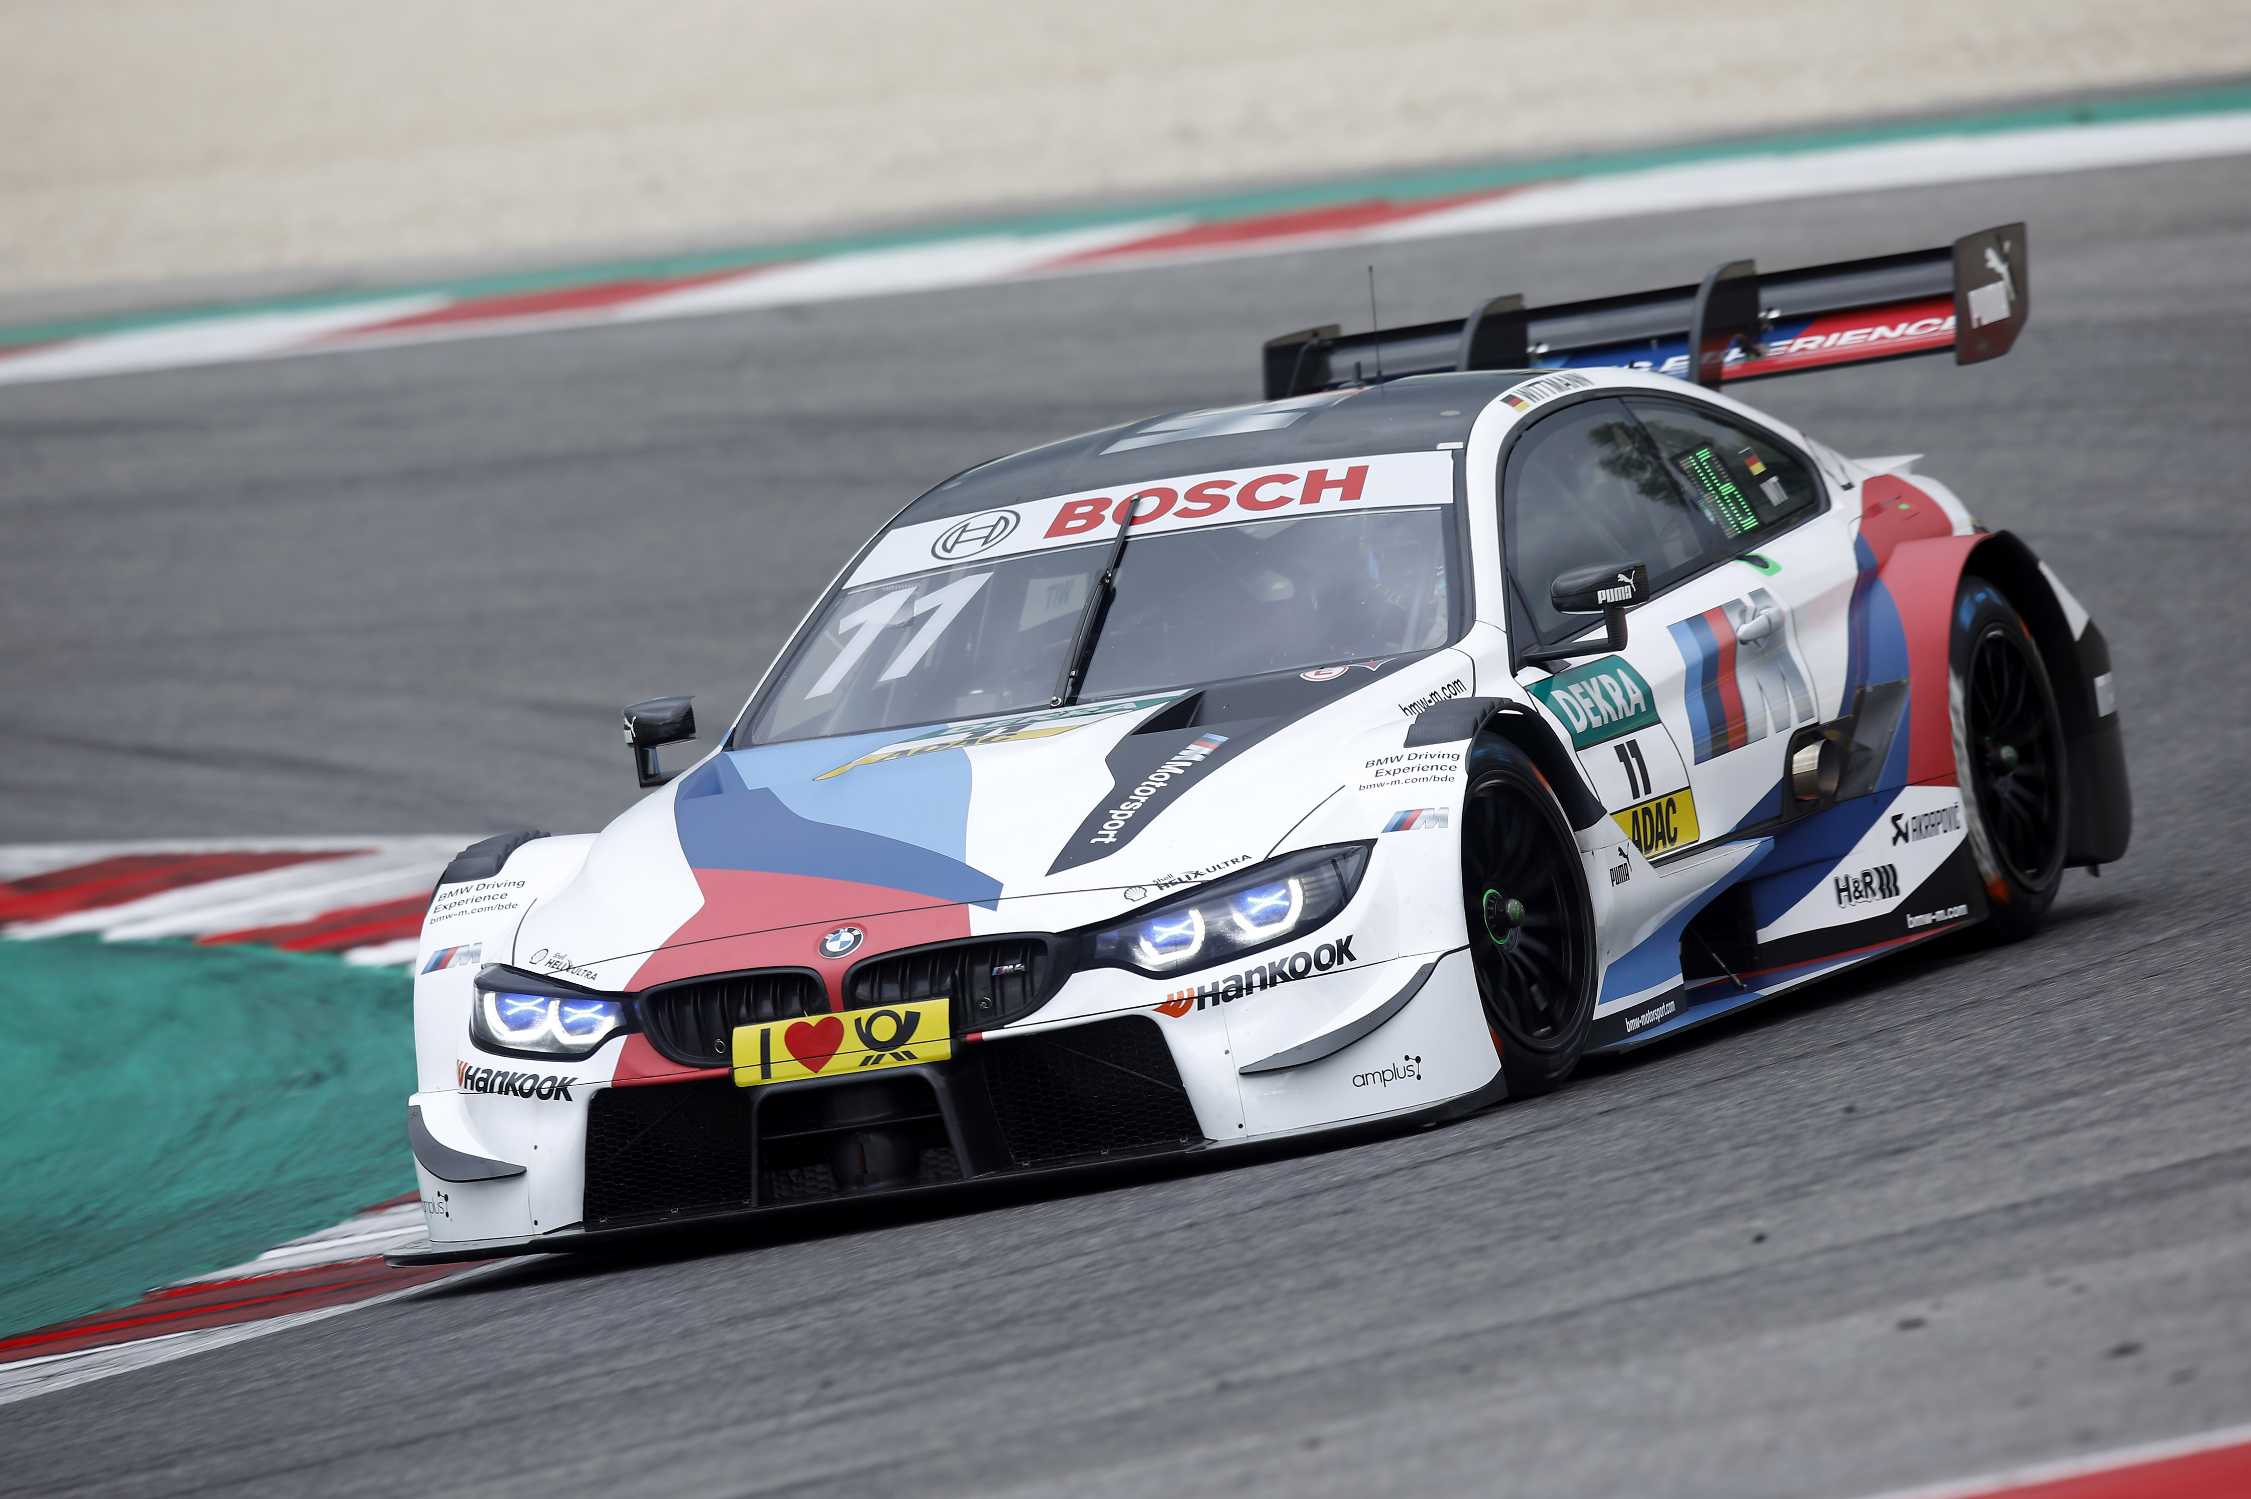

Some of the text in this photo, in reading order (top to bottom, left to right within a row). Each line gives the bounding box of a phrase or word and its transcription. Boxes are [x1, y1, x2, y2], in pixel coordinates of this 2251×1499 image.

[1044, 464, 1370, 538] BOSCH
[803, 571, 994, 701] 11
[1550, 668, 1647, 735] DEKRA
[1365, 751, 1461, 769] BMW Driving
[1374, 762, 1458, 779] Experience
[1613, 738, 1652, 800] 11
[1358, 775, 1456, 792] bmw-m.com/bde
[1089, 760, 1193, 845] Motorsport
[1630, 797, 1678, 853] ADAC
[1205, 854, 1253, 873] ULTRA
[433, 892, 509, 914] Experience
[437, 880, 526, 902] BMW Driving
[429, 902, 519, 926] bmw-m.com/bde
[1197, 935, 1358, 1011] Hankook
[760, 1028, 773, 1080] I
[464, 1065, 578, 1102] Hankook
[1352, 1058, 1416, 1088] amplus
